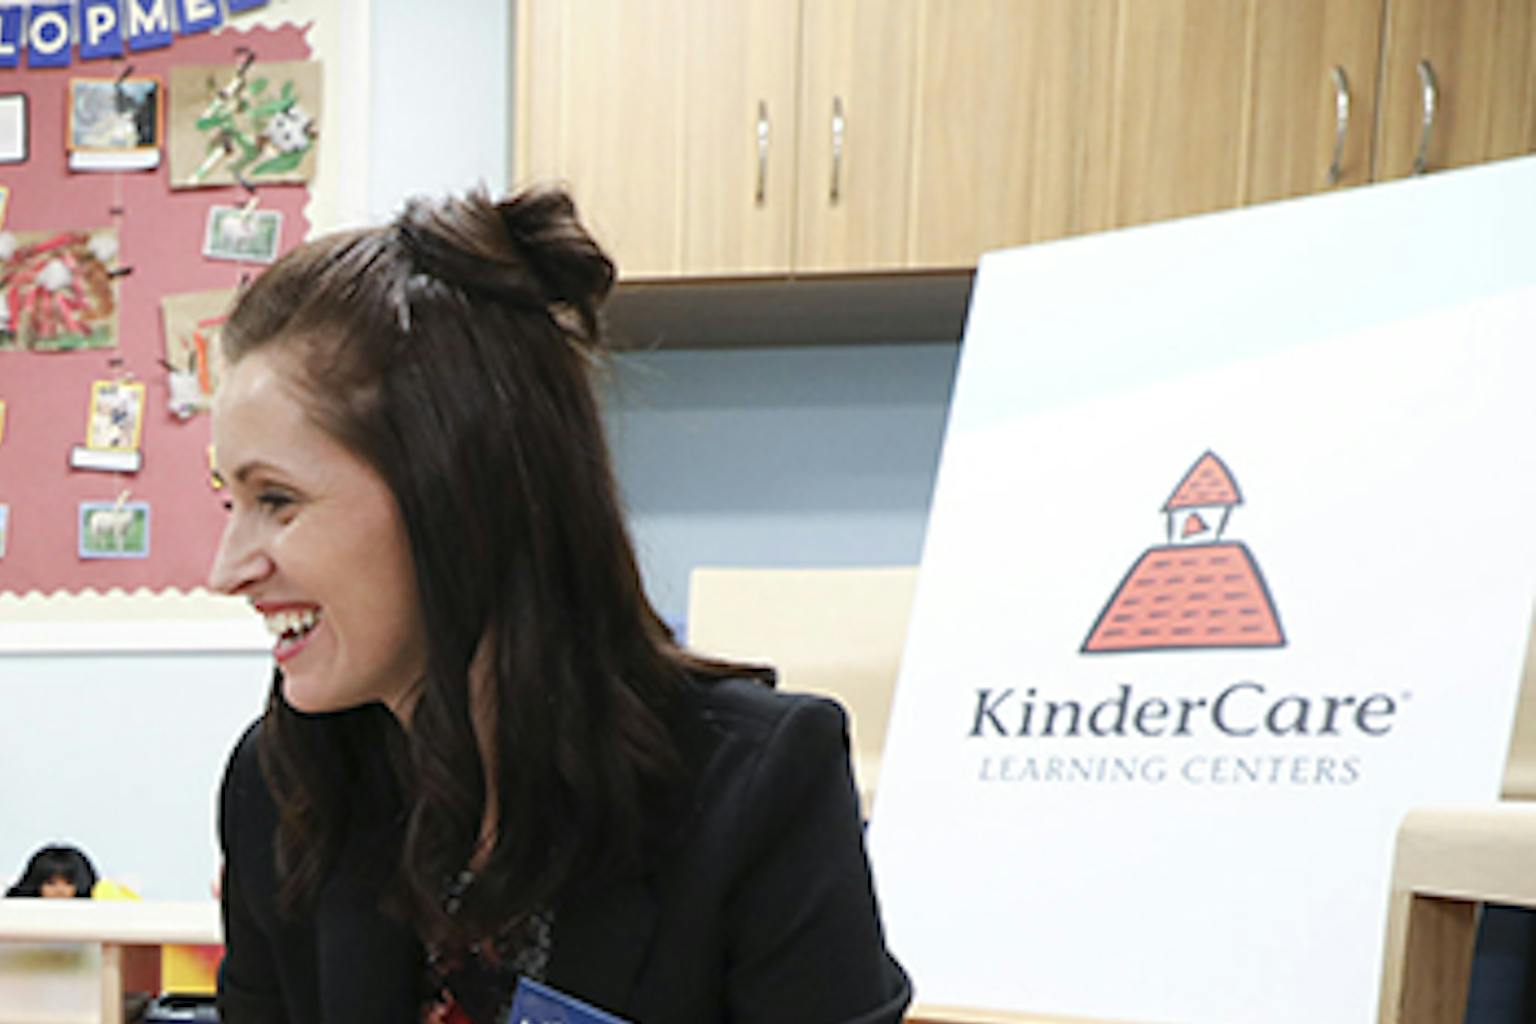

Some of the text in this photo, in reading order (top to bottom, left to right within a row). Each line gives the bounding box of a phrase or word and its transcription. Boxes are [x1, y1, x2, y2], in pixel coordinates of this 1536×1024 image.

[968, 681, 1398, 738] KinderCare
[978, 755, 1362, 785] LEARNING CENTERS
